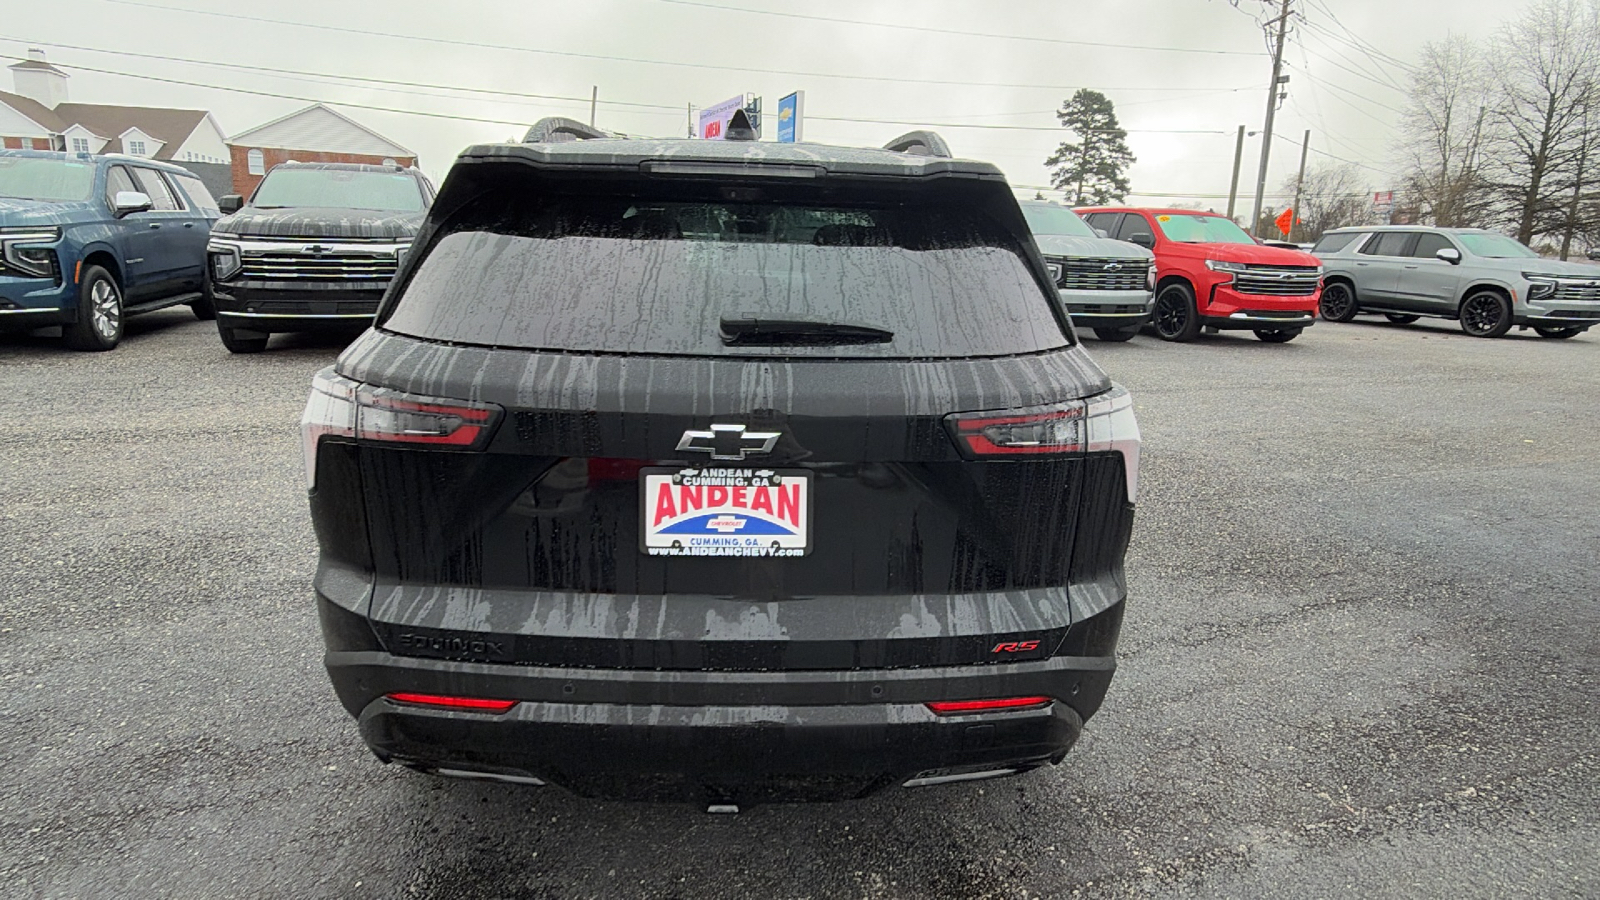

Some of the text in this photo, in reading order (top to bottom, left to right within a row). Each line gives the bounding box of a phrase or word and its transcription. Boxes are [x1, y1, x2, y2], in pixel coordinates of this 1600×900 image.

[700, 468, 753, 478] ANDEAN
[682, 477, 770, 487] CUMMING, GA
[653, 482, 800, 529] ANDEAN
[690, 537, 764, 547] CUMMING, GA.
[648, 546, 804, 557] www.ANDEANCHEVY.com
[400, 632, 503, 654] EQUINOX
[991, 640, 1040, 653] RS
